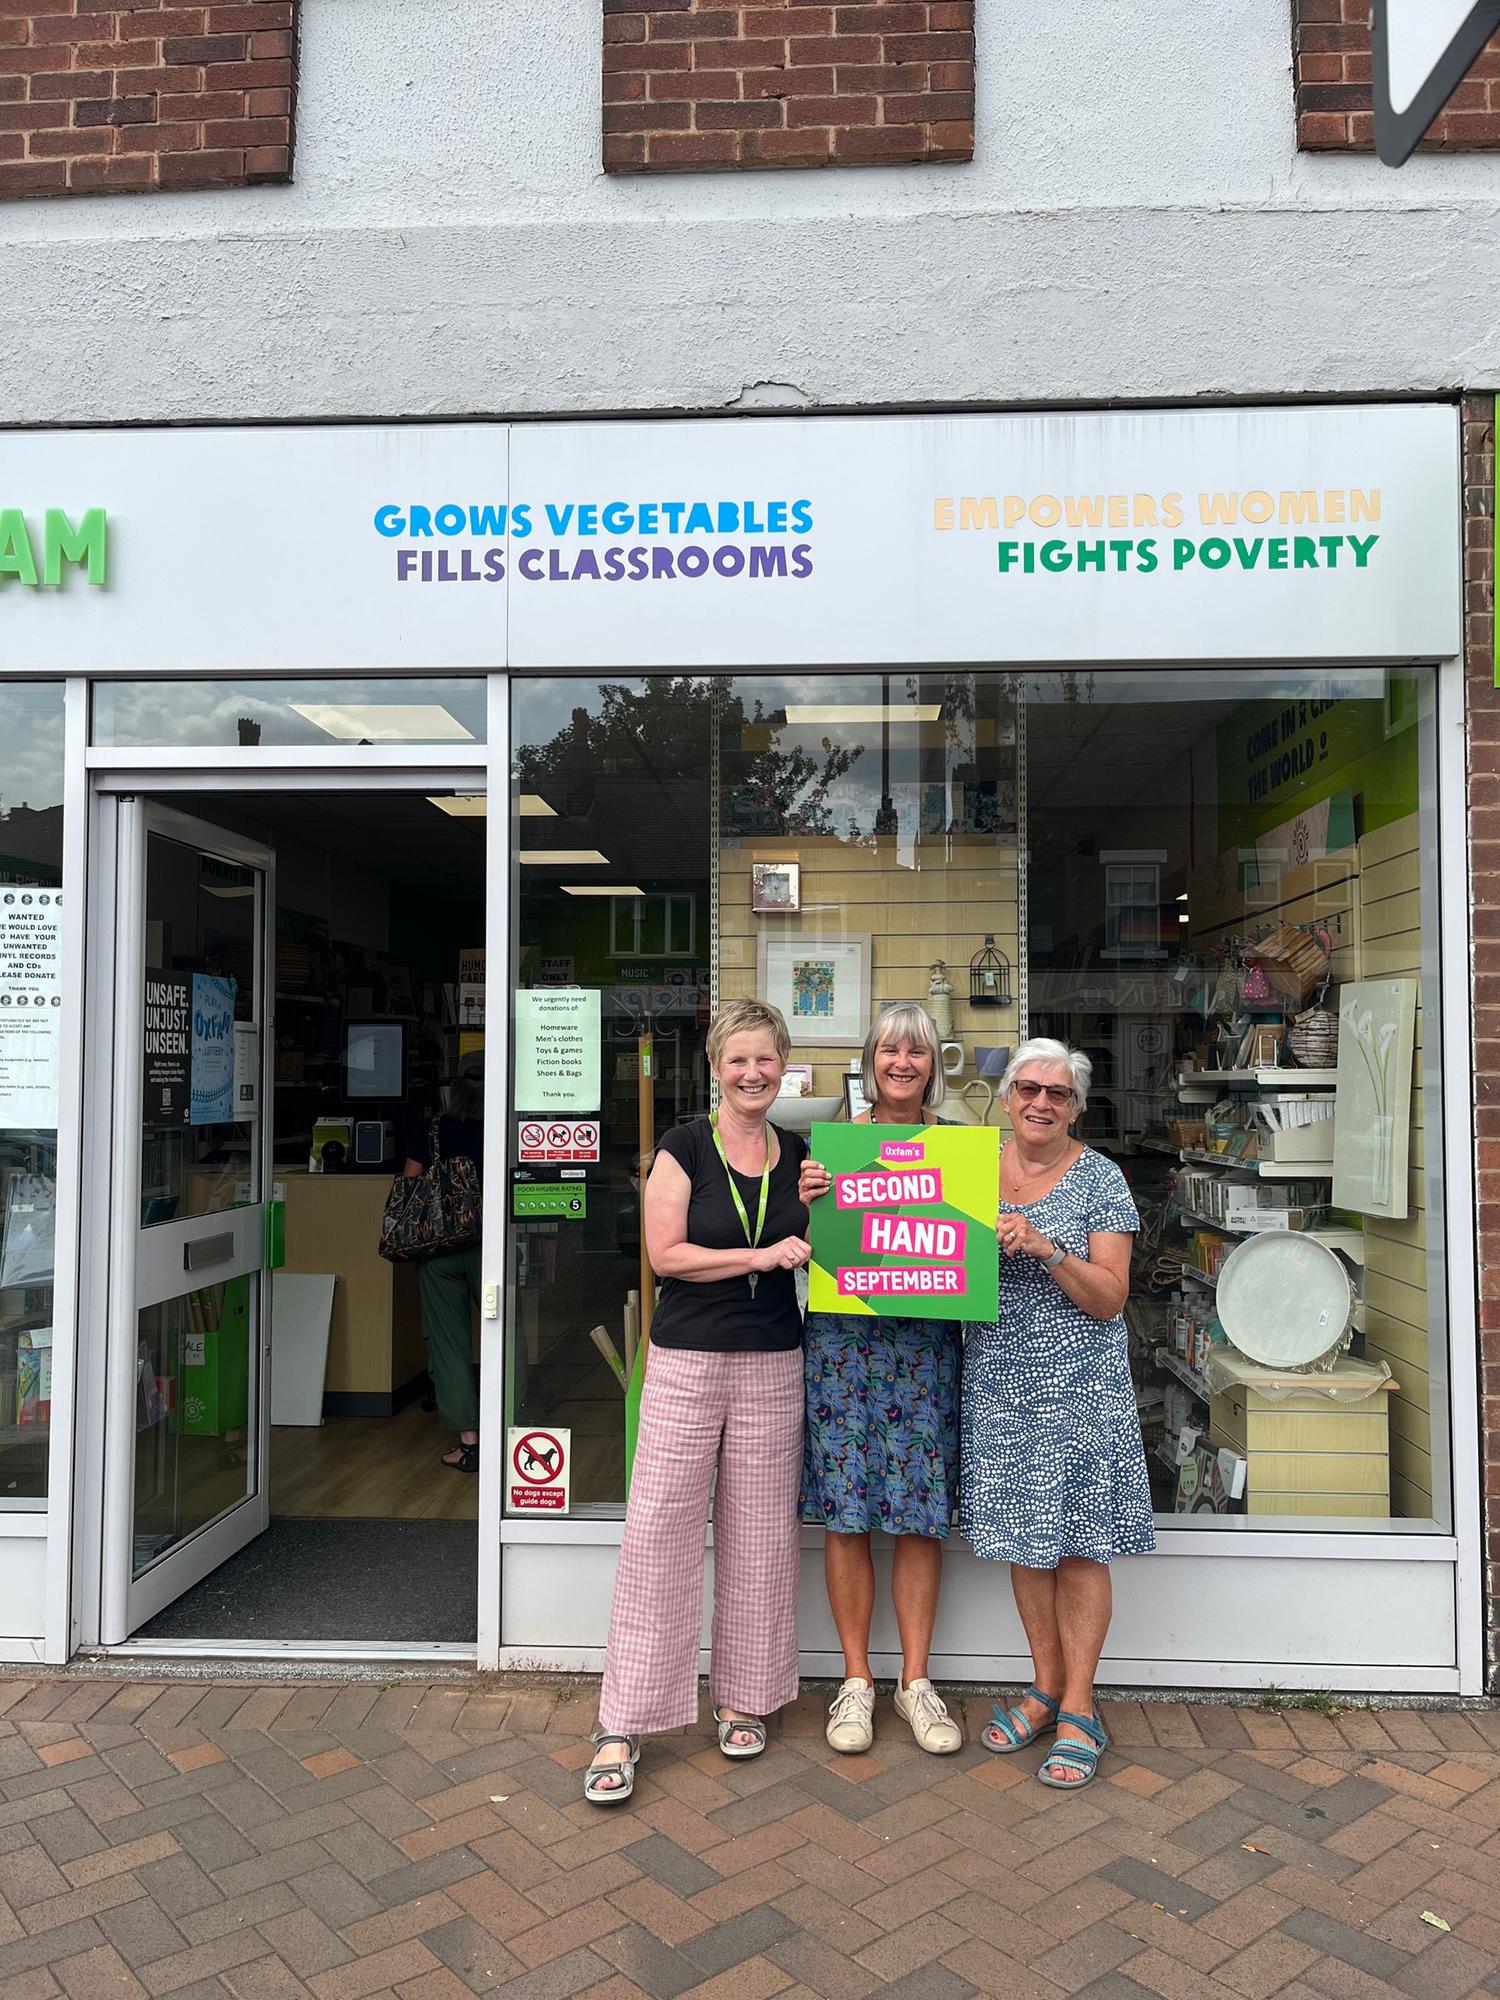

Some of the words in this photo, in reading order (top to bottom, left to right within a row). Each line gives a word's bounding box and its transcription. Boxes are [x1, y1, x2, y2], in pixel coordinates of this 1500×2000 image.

[374, 504, 532, 538] GROWS
[545, 499, 813, 536] VEGETABLES
[934, 493, 1183, 530] EMPOWERS
[1199, 490, 1381, 525] WOMEN
[397, 549, 505, 582] FILLS
[518, 544, 813, 581] CLASSROOMS
[998, 539, 1159, 573] FIGHTS
[1173, 535, 1380, 570] POVERTY
[1281, 704, 1296, 741] IN
[1248, 768, 1268, 804] THE
[1270, 738, 1315, 789] WORLD
[540, 959, 571, 968] STAFF
[621, 968, 649, 978] MUSIC
[542, 972, 568, 981] ONLY
[146, 981, 189, 1008] UNSAFE.
[146, 1006, 189, 1031] UNJUST.
[194, 1009, 231, 1042] OXFAM
[146, 1031, 189, 1055] UNSEEN.
[536, 1047, 552, 1055] Toys
[566, 1070, 582, 1078] Bags
[885, 1146, 921, 1157] Oxfam's
[841, 1174, 936, 1203] SECOND
[572, 1200, 579, 1210] 5
[870, 1218, 956, 1256] HAND
[843, 1270, 959, 1291] SEPTEMBER
[520, 1498, 538, 1506] guide
[539, 1498, 556, 1506] dogs
[524, 1489, 540, 1498] dogs
[542, 1490, 564, 1498] except
